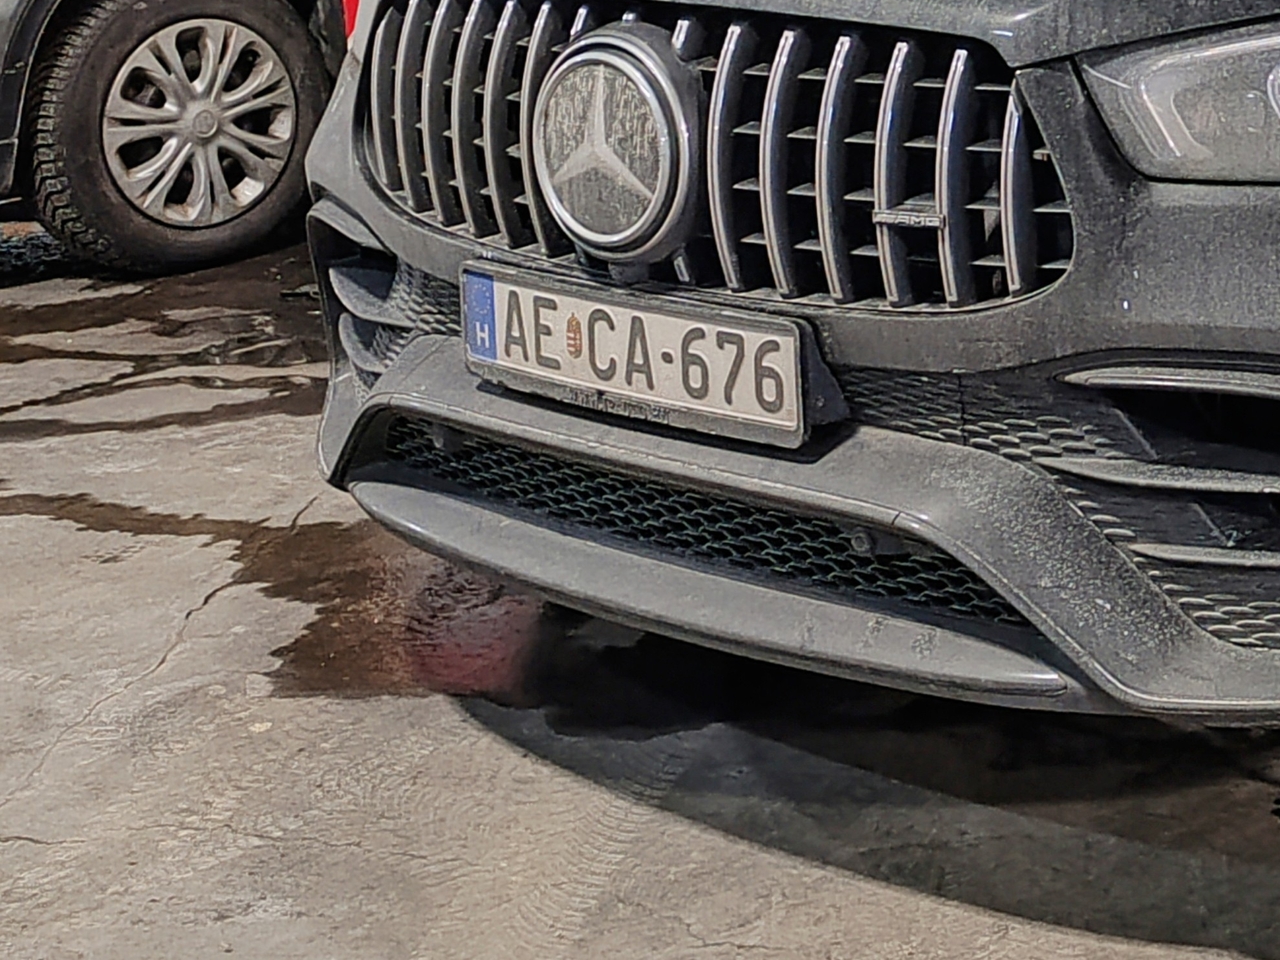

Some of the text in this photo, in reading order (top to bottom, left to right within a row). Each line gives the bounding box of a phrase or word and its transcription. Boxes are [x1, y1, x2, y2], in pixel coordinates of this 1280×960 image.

[894, 214, 941, 227] AMG
[474, 321, 490, 349] H
[504, 289, 785, 414] AE CA-676
